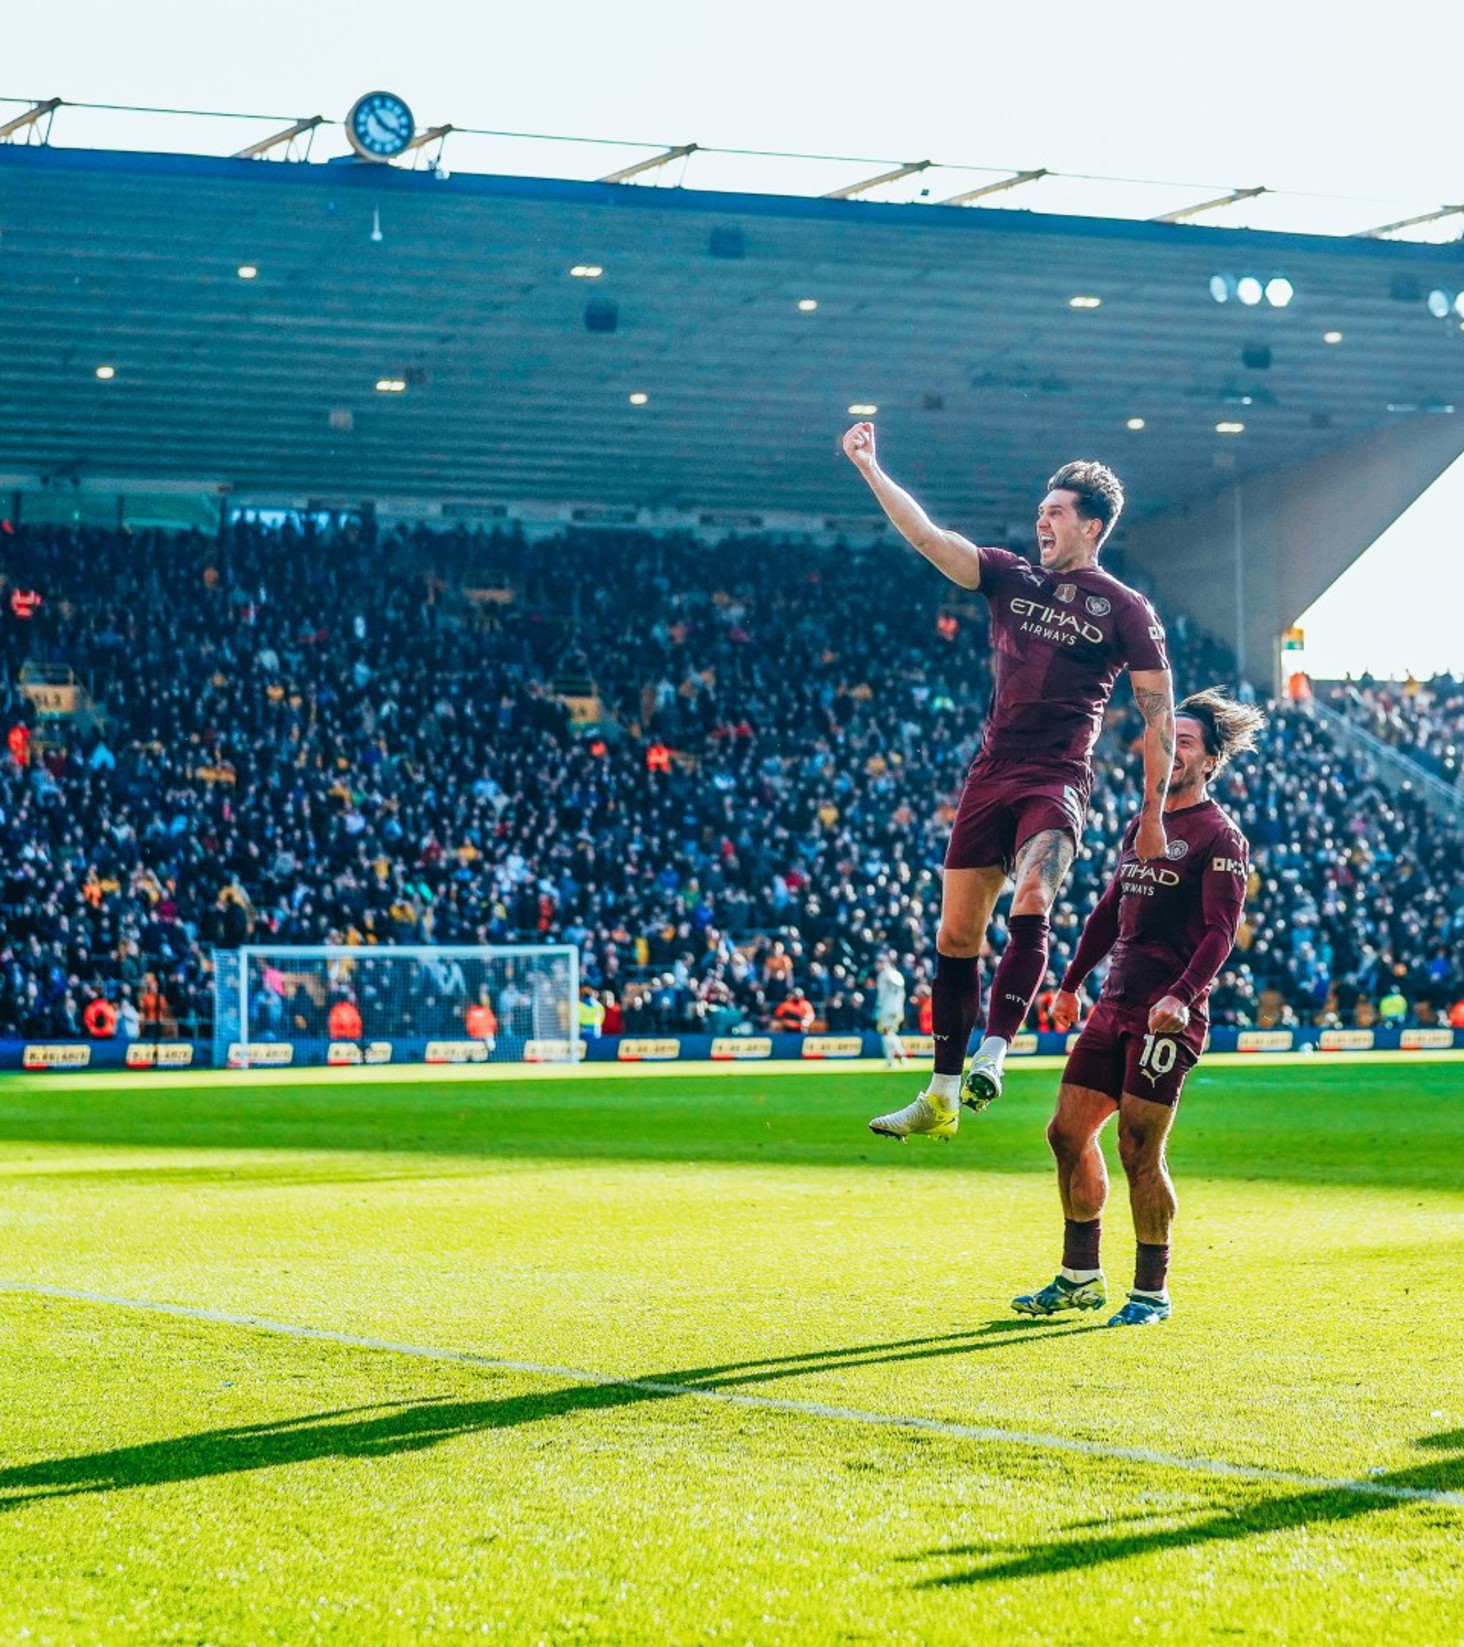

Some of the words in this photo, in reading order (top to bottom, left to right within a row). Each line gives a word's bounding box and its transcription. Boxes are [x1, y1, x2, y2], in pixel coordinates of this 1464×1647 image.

[1010, 597, 1104, 644] ETIHAD
[1020, 621, 1077, 646] AIRWAYS
[1120, 862, 1180, 887] TIHAD
[1139, 1033, 1177, 1073] 10
